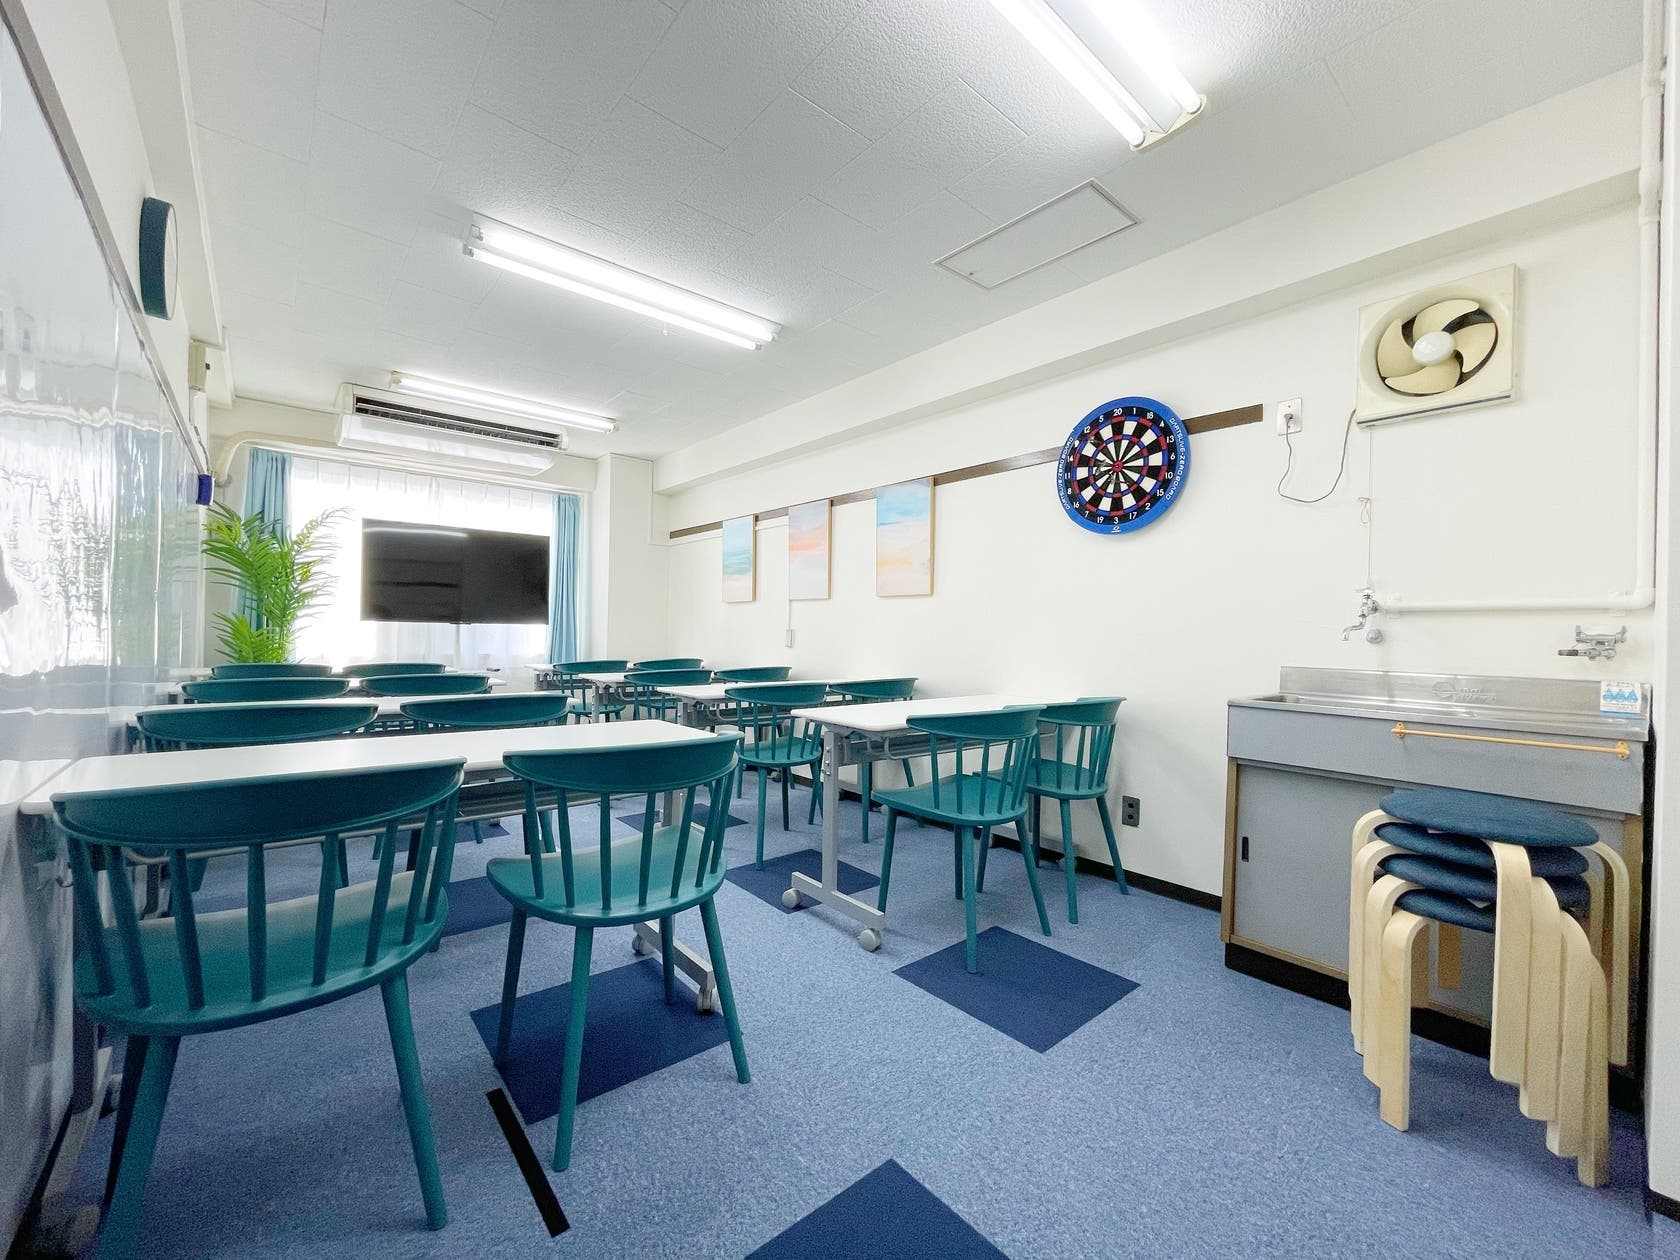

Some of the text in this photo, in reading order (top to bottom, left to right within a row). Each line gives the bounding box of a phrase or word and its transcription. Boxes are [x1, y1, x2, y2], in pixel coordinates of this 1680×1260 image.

[1113, 408, 1123, 416] 20
[1166, 435, 1175, 443] 13
[1156, 489, 1164, 497] 15
[1073, 501, 1080, 509] 16
[1097, 516, 1104, 524] 19
[1129, 512, 1137, 520] 17
